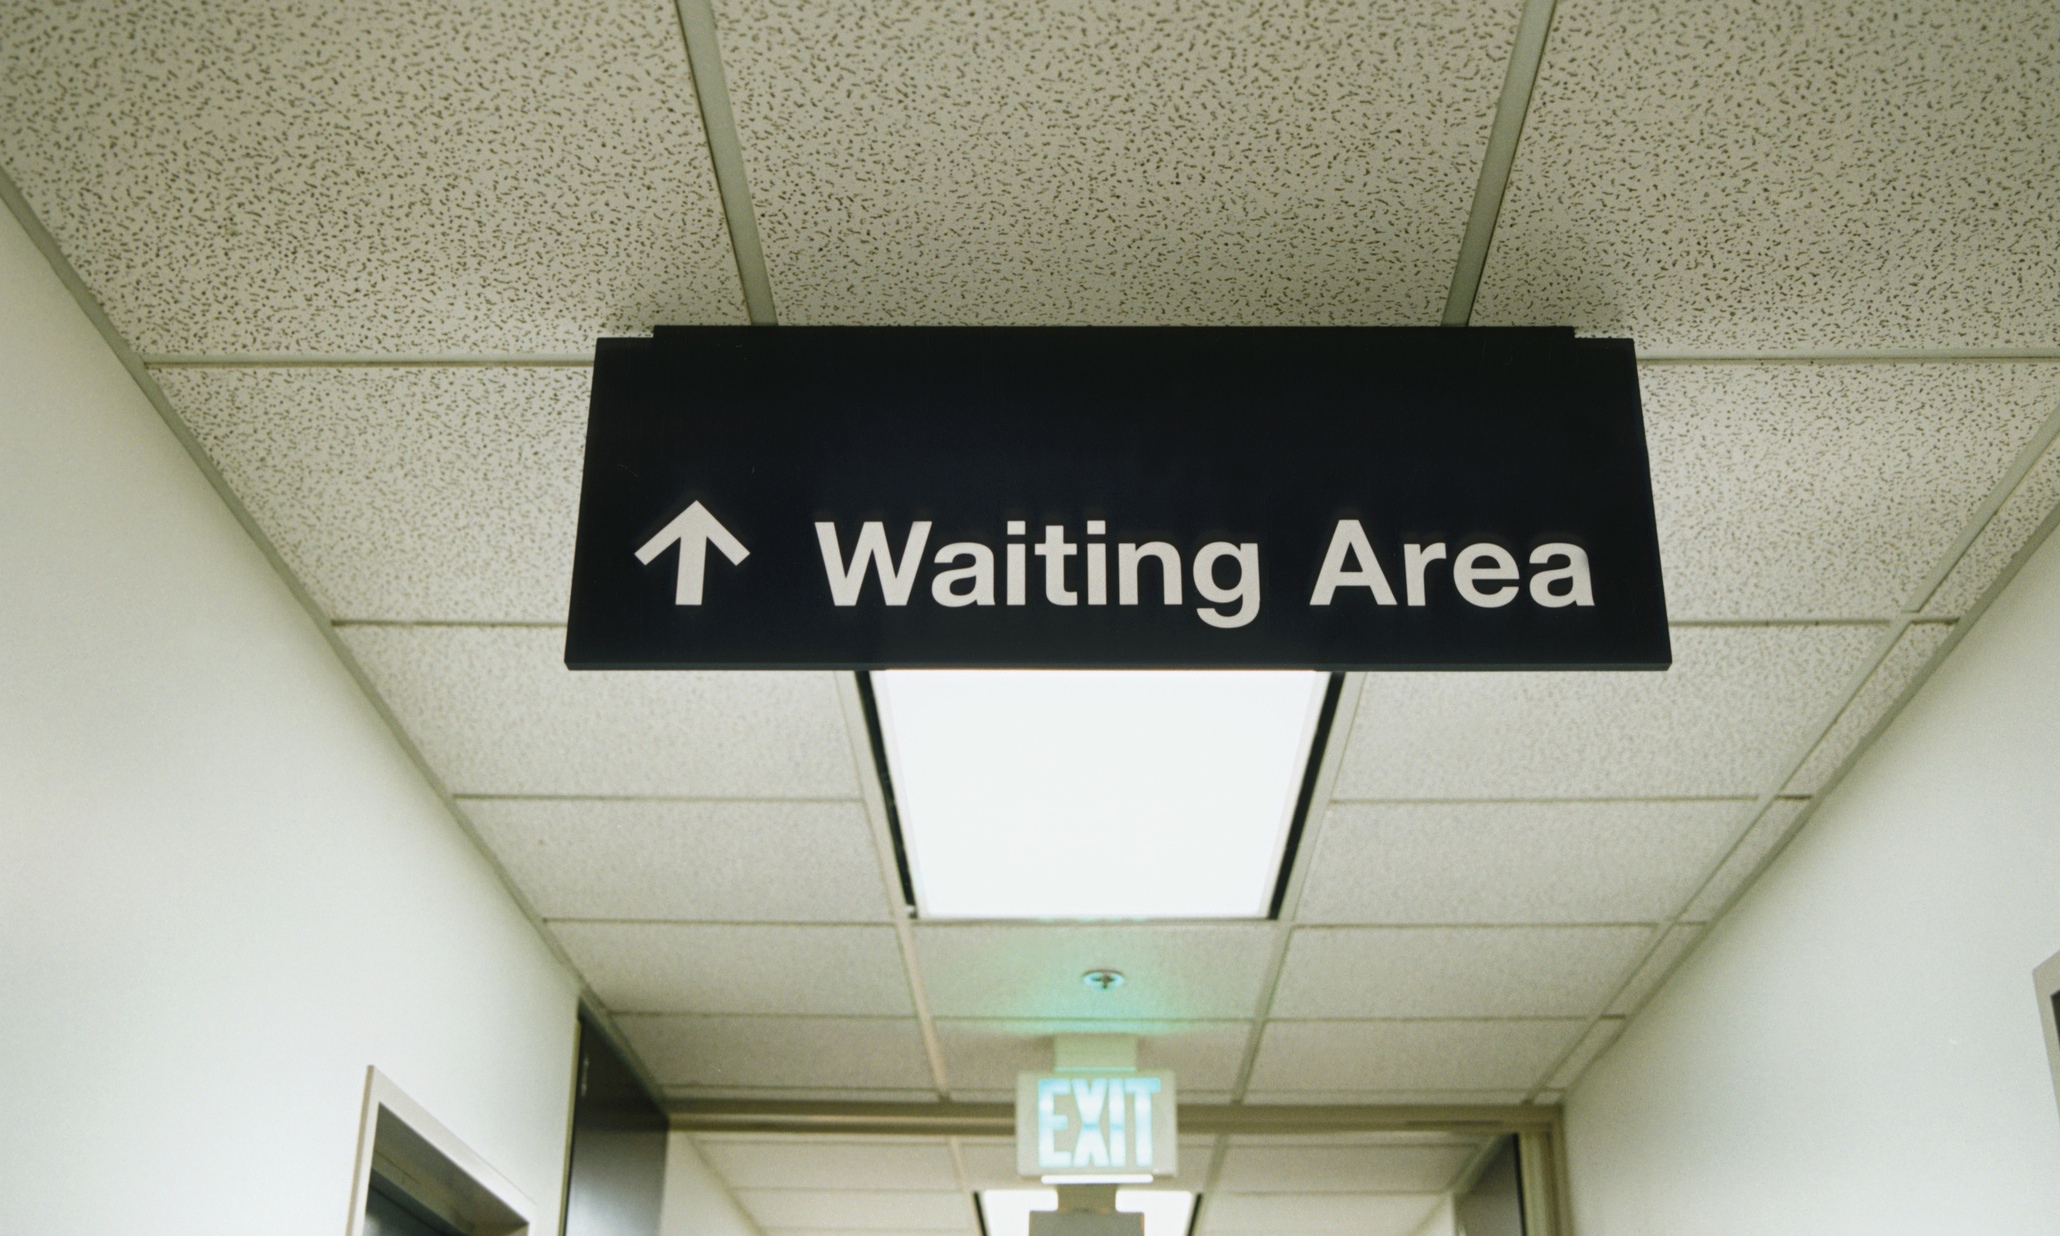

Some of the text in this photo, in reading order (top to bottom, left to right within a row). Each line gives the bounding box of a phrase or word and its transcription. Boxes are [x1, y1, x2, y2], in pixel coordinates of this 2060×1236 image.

[814, 519, 1595, 629] Waiting Area
[1037, 1077, 1161, 1168] EXIT
